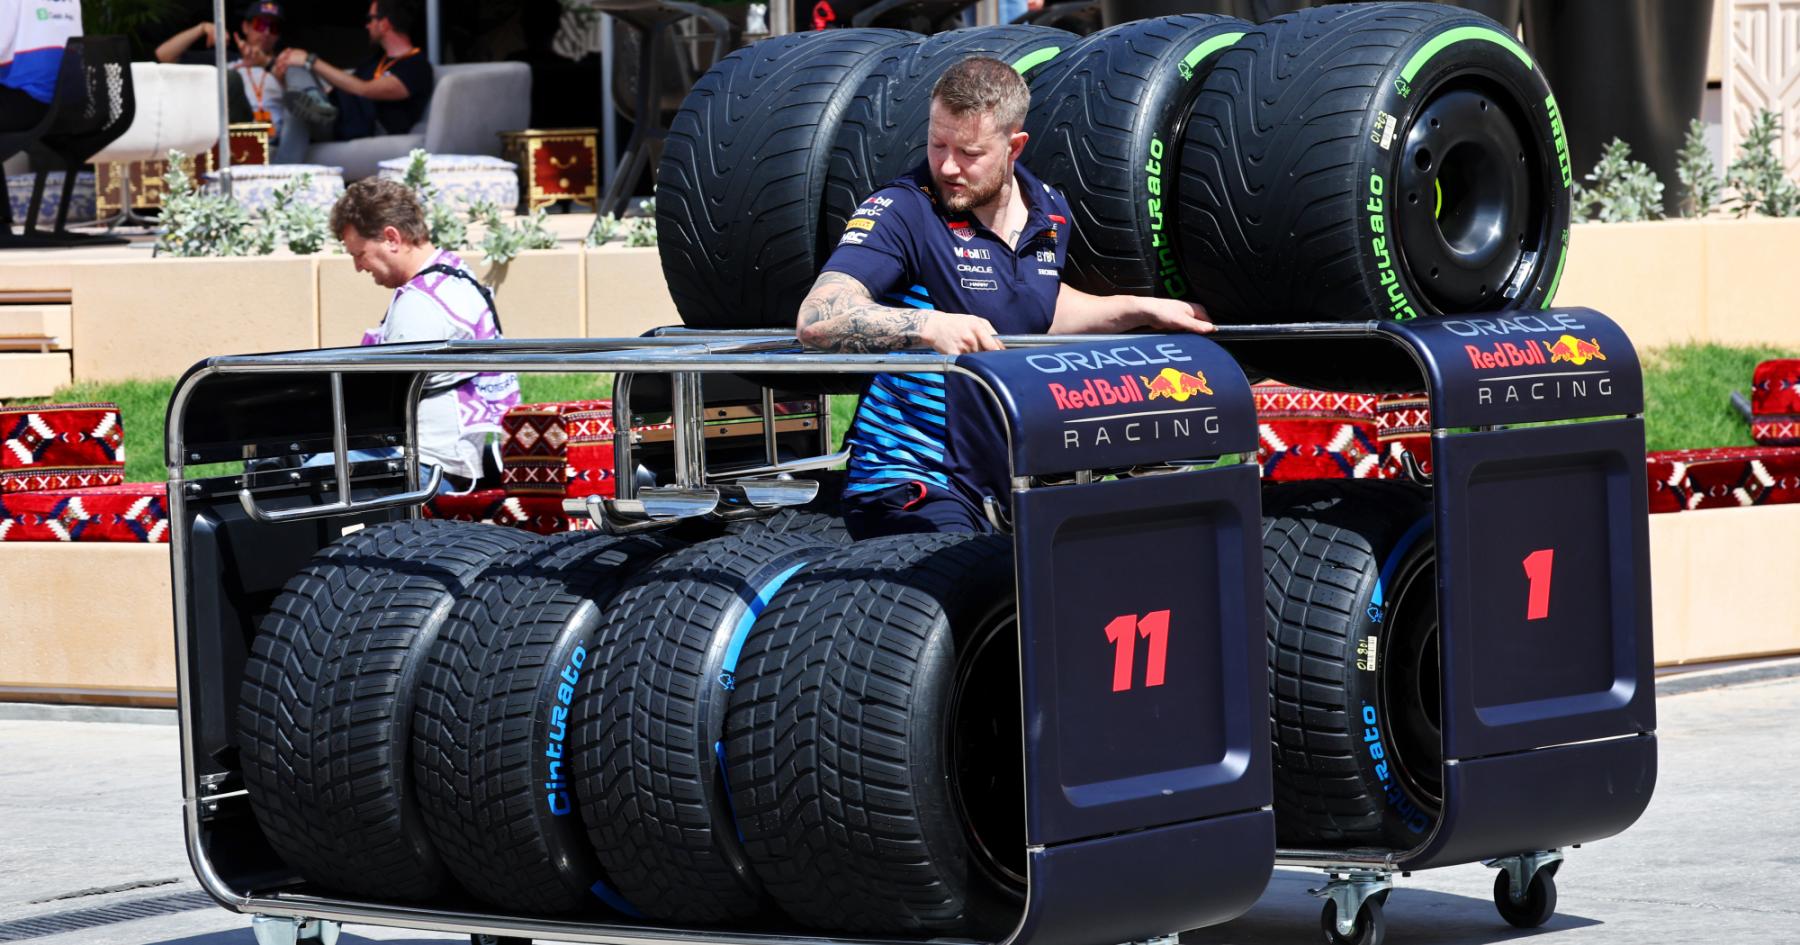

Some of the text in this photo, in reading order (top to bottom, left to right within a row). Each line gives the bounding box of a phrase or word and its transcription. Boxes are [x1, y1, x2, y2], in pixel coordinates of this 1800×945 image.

[1545, 93, 1573, 188] PIRELLI
[1145, 138, 1187, 299] Cinturato
[954, 247, 980, 259] Mobil
[957, 264, 993, 274] ORACLE
[1442, 314, 1585, 336] ORACLE
[1026, 343, 1192, 373] ORACLE
[1464, 339, 1546, 369] Red Bull
[1048, 374, 1144, 410] Red Bull
[1478, 378, 1612, 405] RACING
[1064, 416, 1219, 448] RACING
[1523, 549, 1554, 620] 1
[1104, 609, 1170, 692] 11
[546, 645, 586, 816] Cinturato
